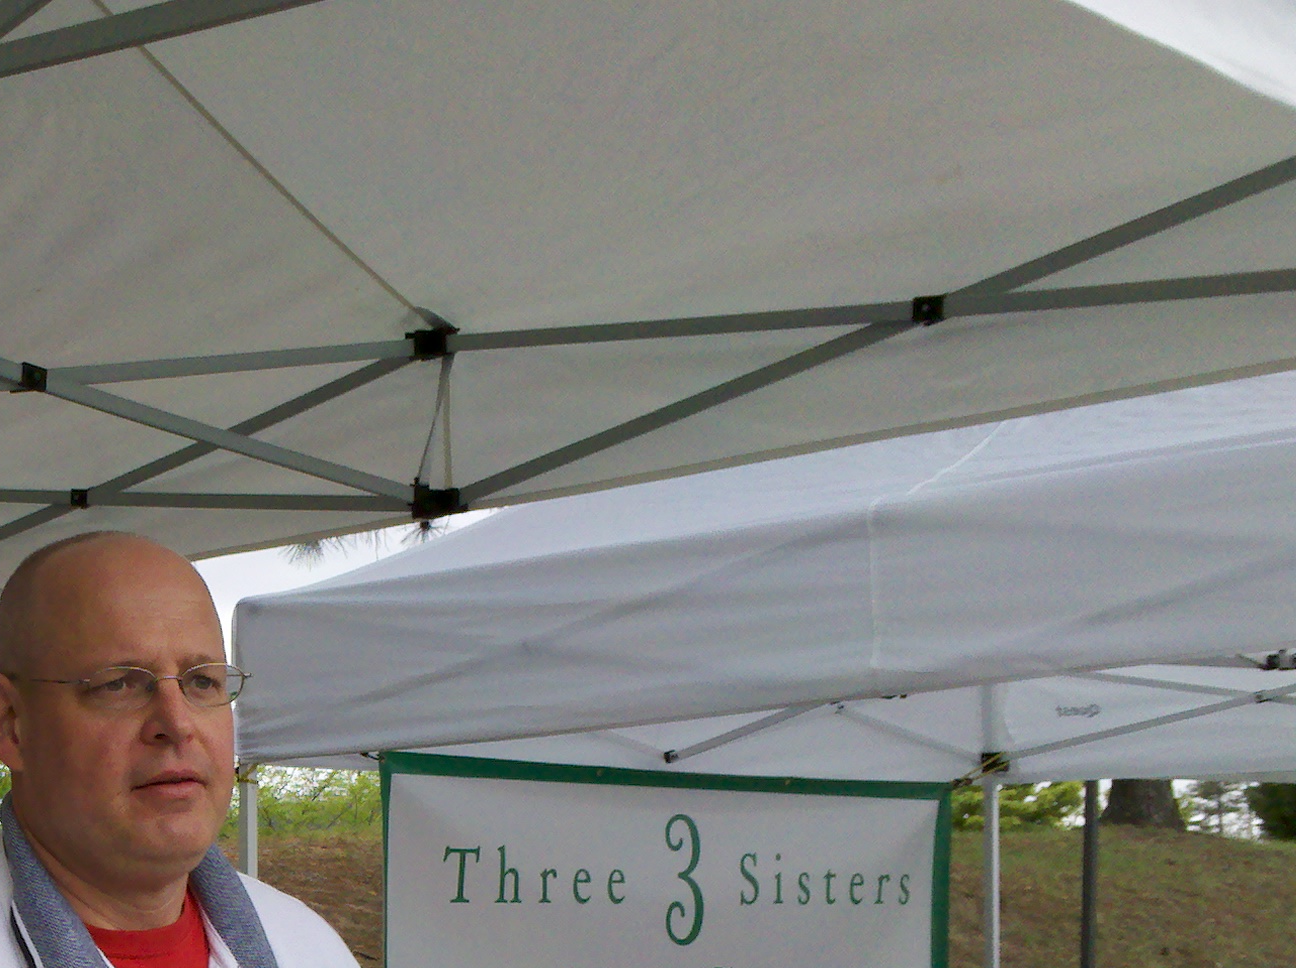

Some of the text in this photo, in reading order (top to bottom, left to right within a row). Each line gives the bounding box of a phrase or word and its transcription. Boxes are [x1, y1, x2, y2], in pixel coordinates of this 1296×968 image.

[443, 813, 911, 946] Three 3 Sisters
